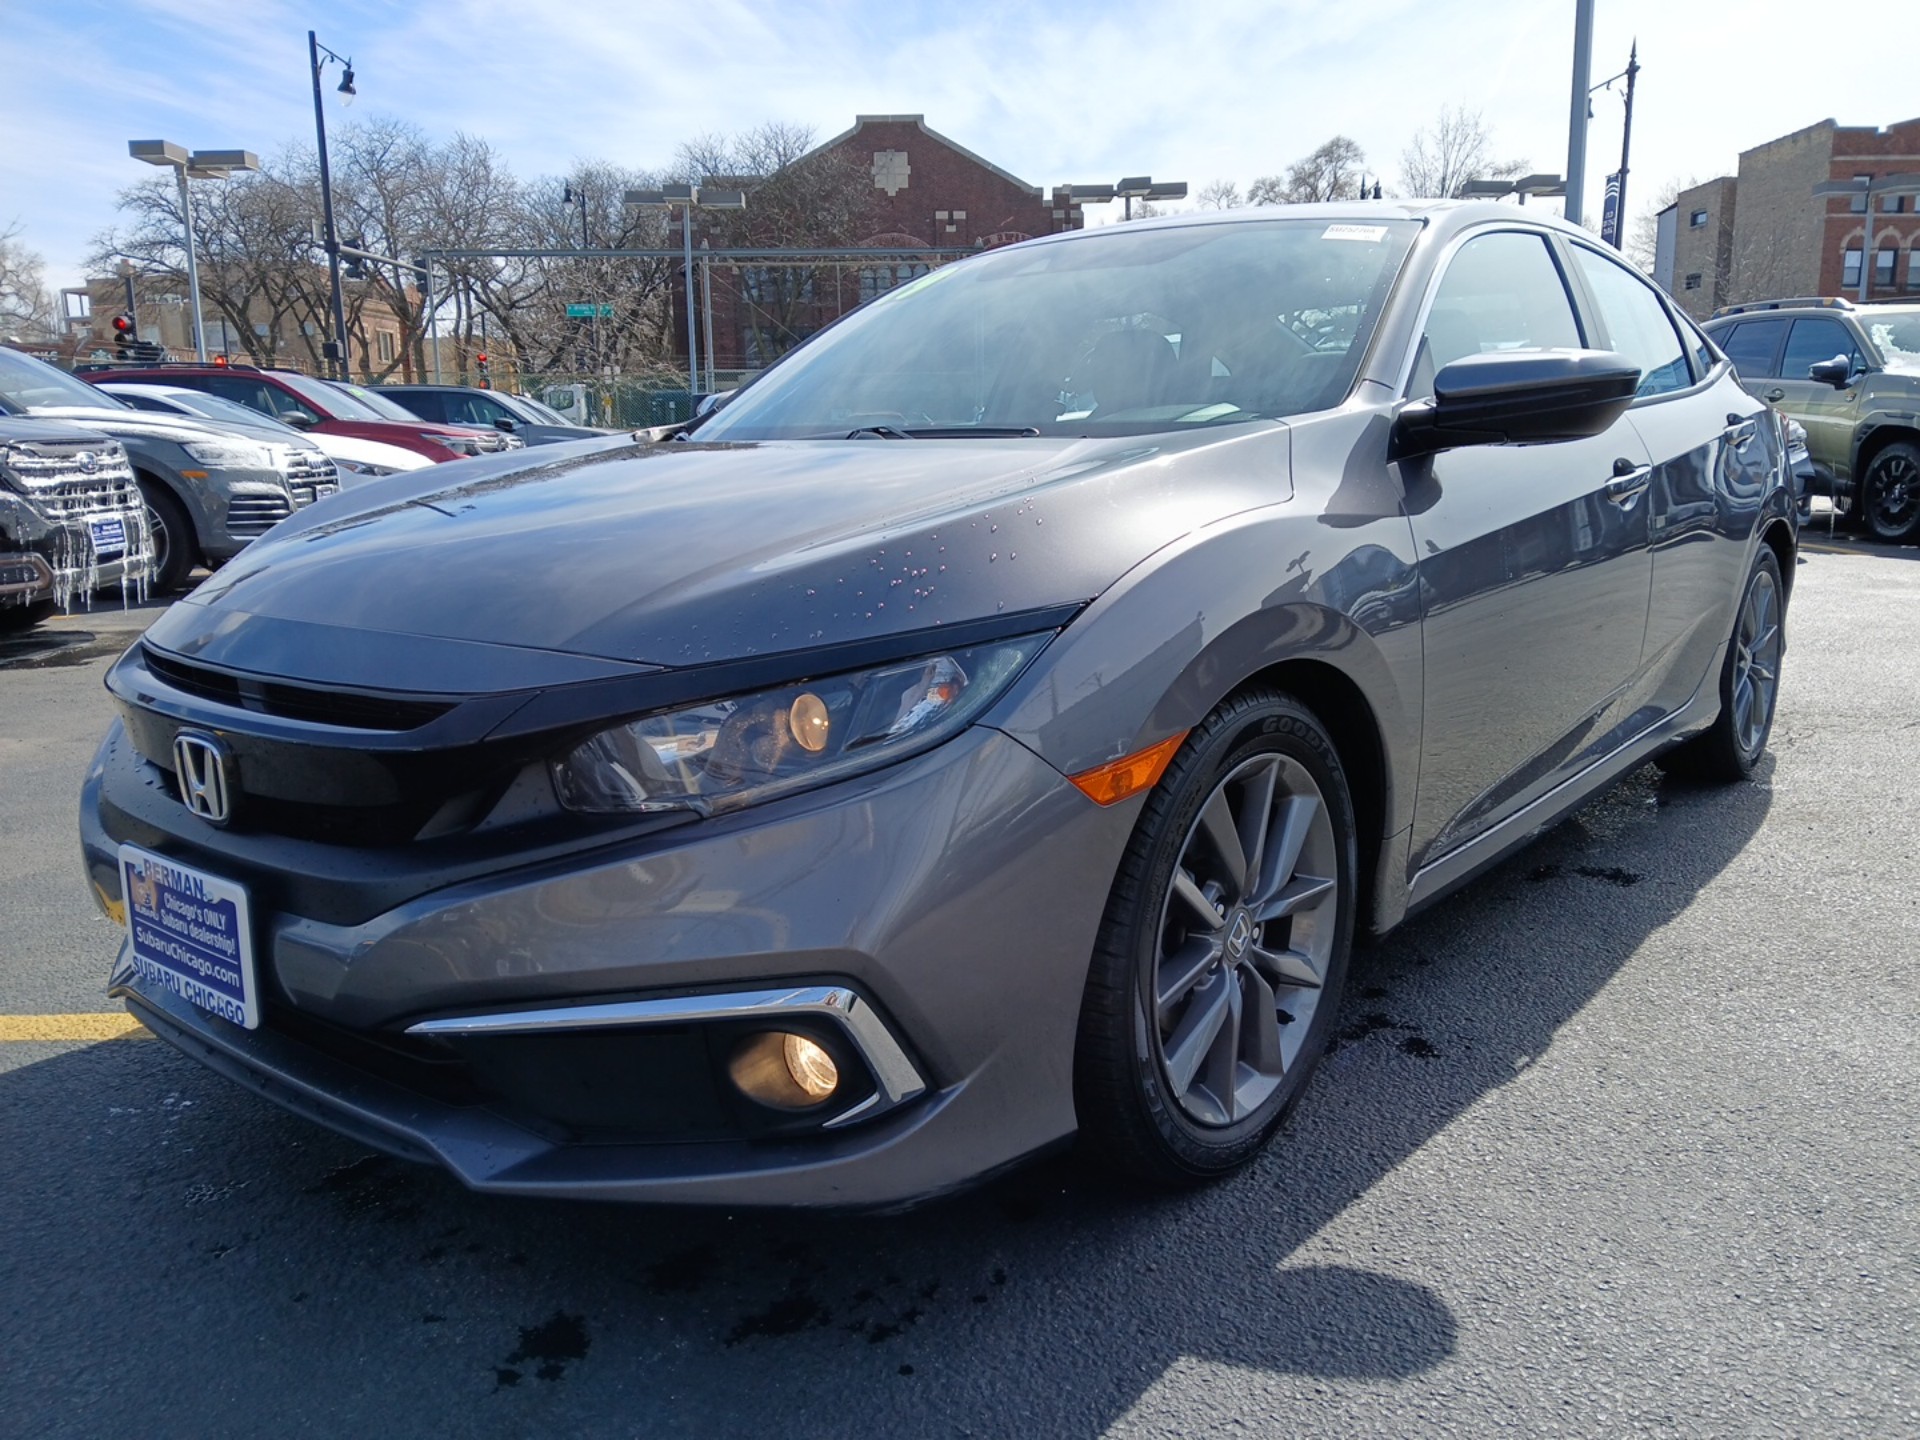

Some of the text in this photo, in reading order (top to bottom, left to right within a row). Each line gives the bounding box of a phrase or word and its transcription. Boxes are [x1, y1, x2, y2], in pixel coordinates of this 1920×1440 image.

[143, 858, 204, 900] BERMAN
[161, 909, 236, 956] Subaru dealership!
[163, 892, 226, 931] Chicago's ONLY
[135, 926, 240, 988] SubaruChicago.com
[132, 956, 245, 1026] SUBARU CHICAGO
